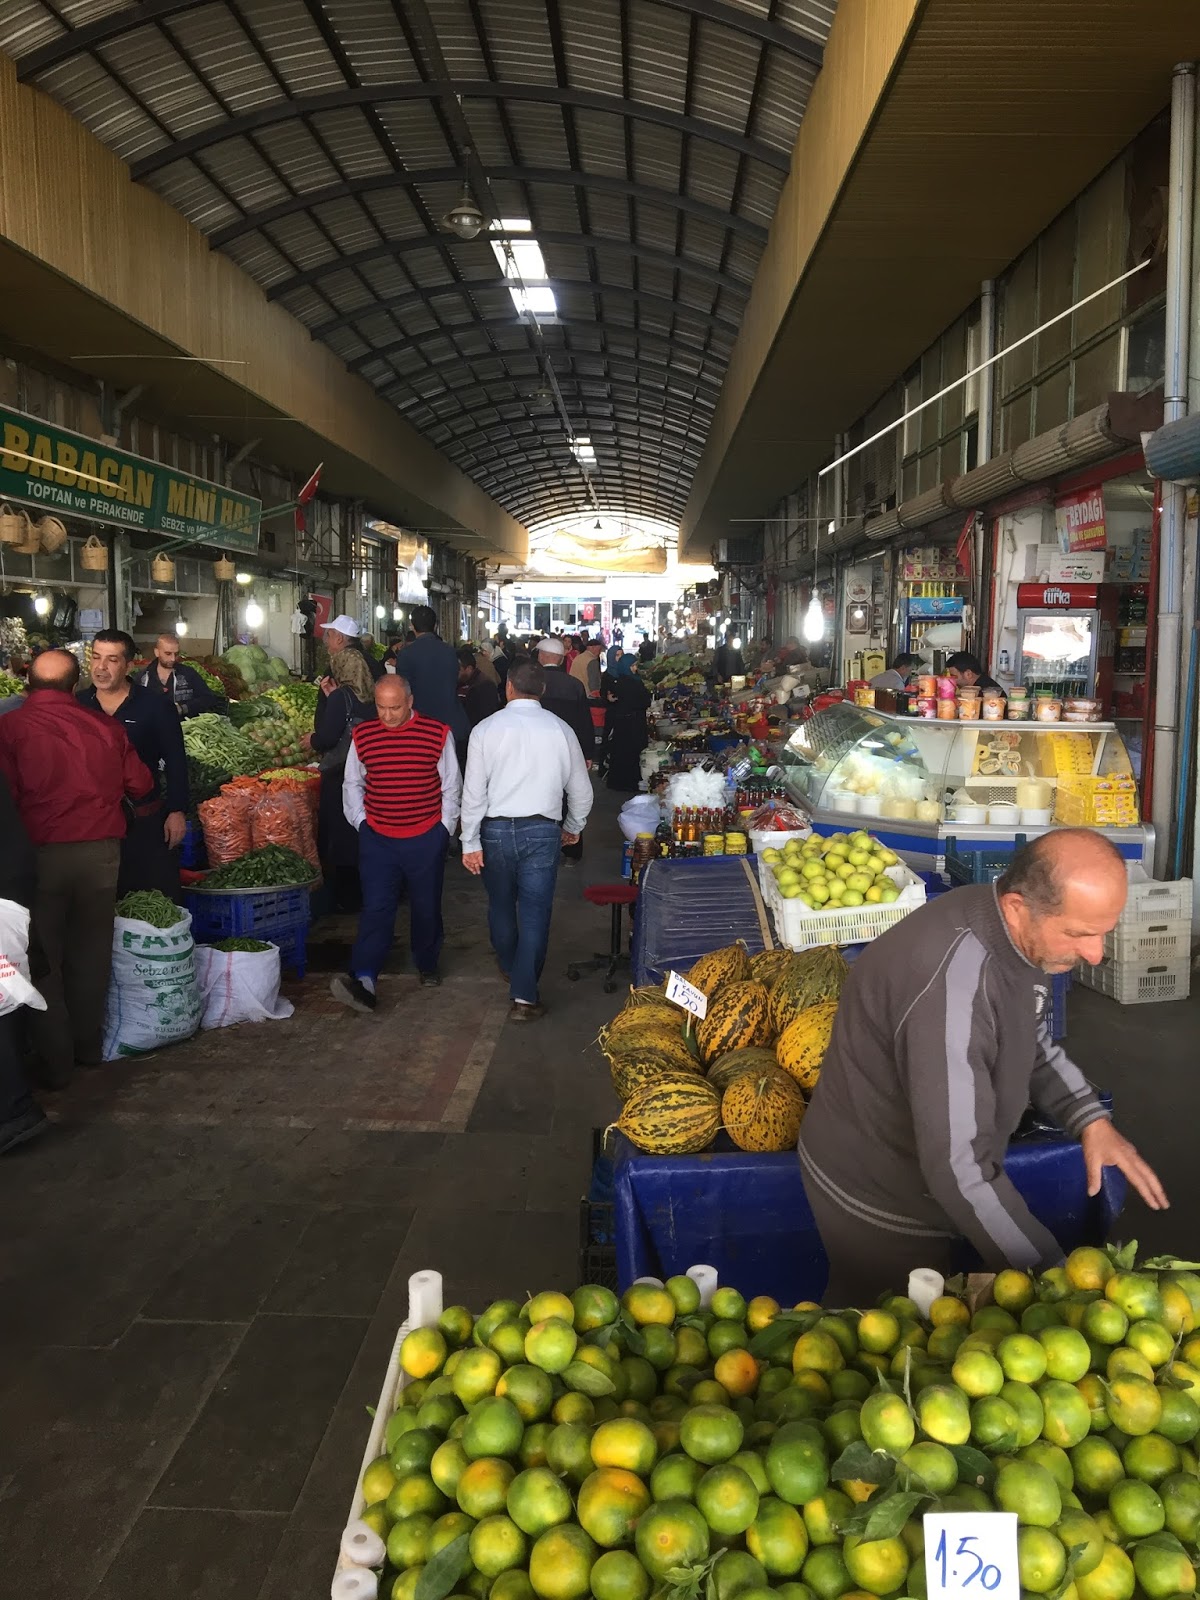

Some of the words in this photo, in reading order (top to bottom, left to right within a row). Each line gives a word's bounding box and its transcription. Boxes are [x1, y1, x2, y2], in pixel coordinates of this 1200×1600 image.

[1, 422, 154, 509] BABACAN
[26, 480, 73, 505] TOPTAN
[75, 496, 87, 508] ve
[90, 497, 145, 524] PERAKENDE
[161, 516, 186, 533] SEBZE
[186, 525, 195, 534] ve
[1043, 589, 1070, 604] turka
[672, 984, 698, 1012] 1.50
[935, 1529, 1002, 1590] 1.50
